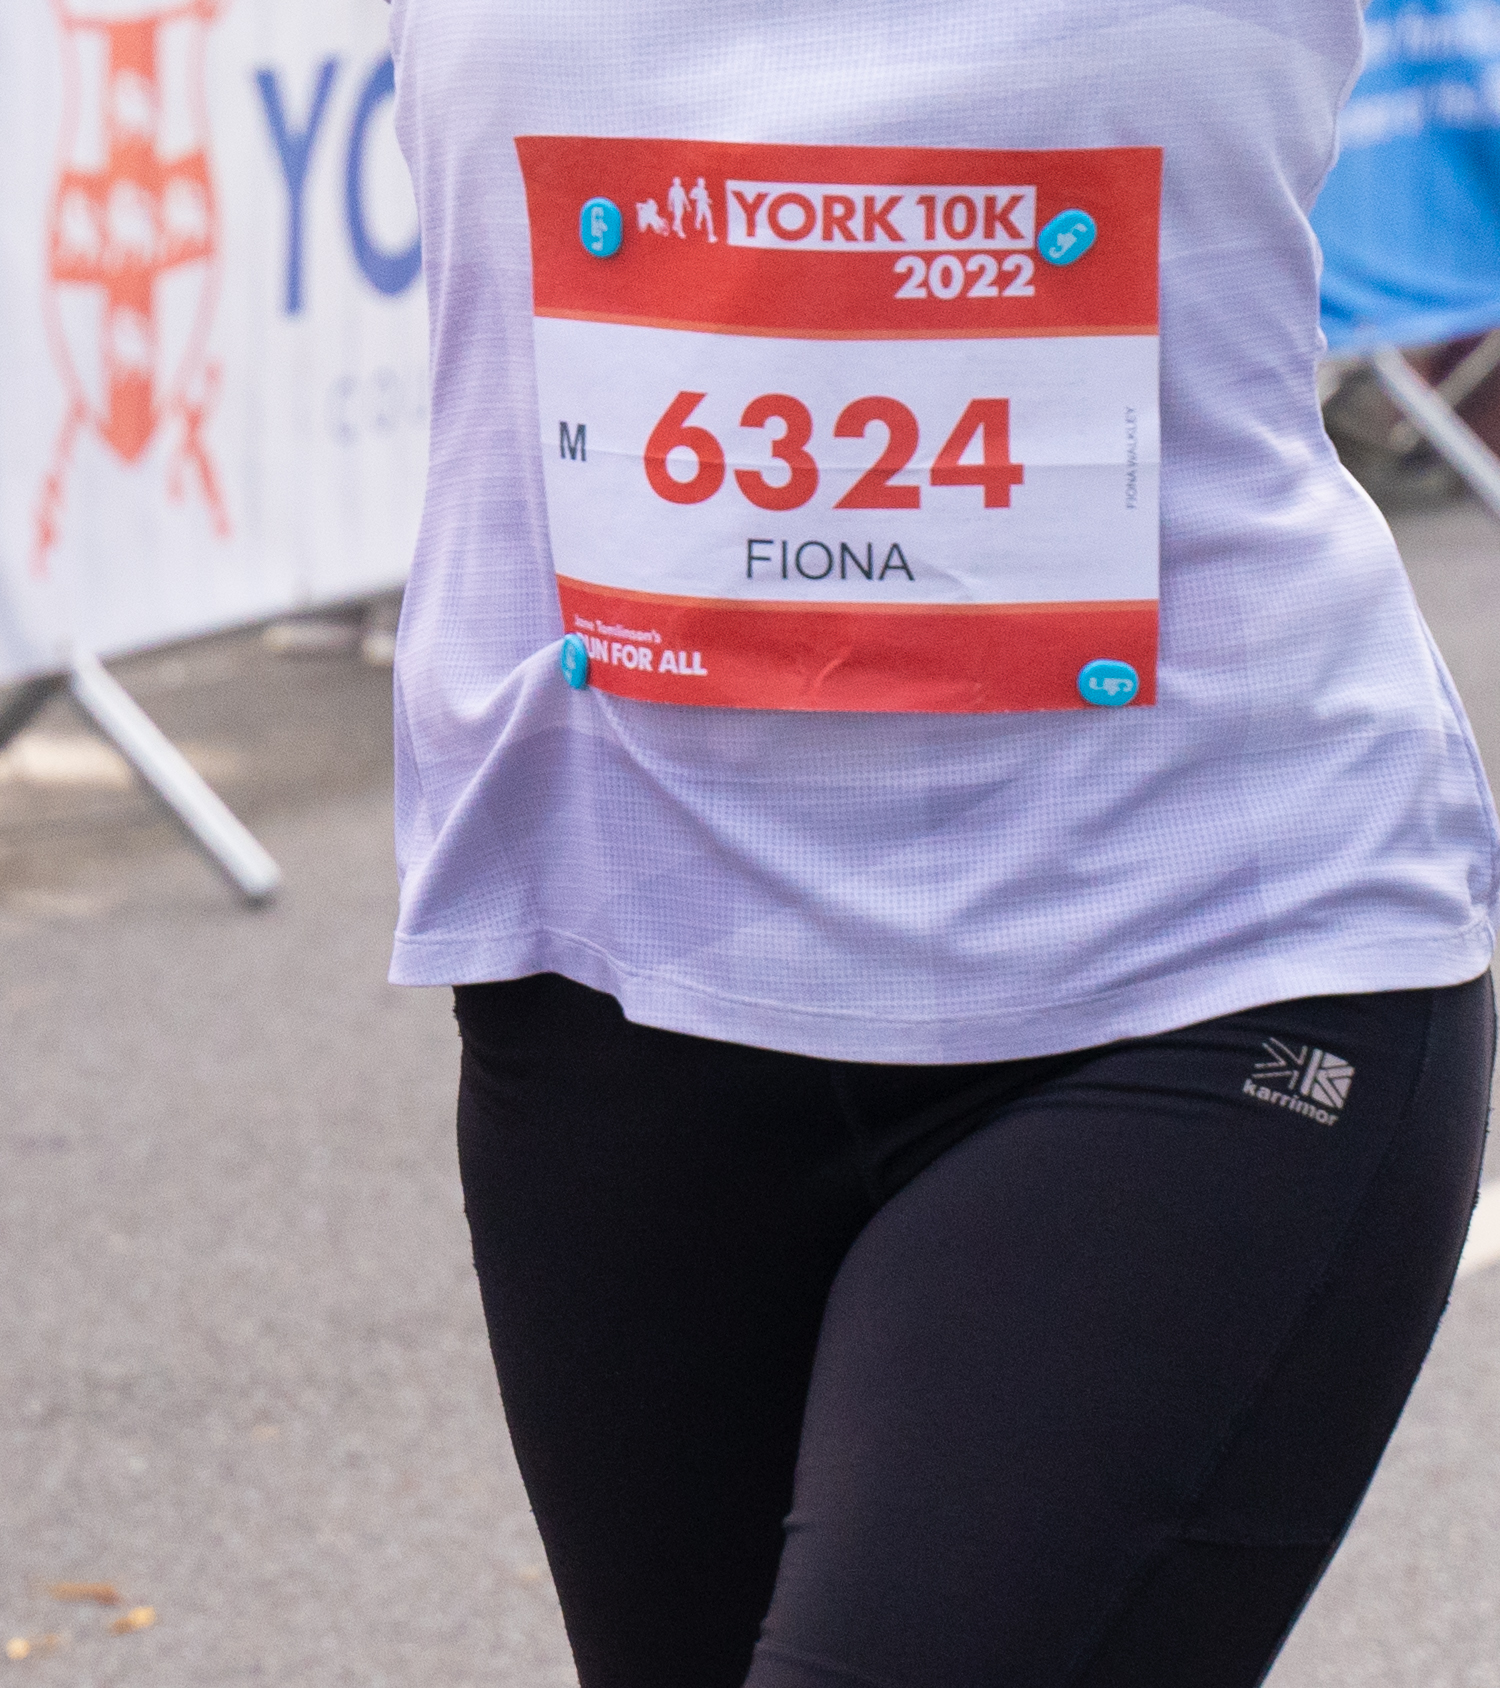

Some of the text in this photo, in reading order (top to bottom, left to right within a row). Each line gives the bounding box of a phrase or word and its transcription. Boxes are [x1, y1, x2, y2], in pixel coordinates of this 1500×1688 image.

[248, 50, 424, 320] YO
[733, 191, 1028, 244] YORK 10K
[893, 253, 1036, 301] 2022
[558, 421, 588, 462] M
[643, 390, 1025, 512] 6324
[745, 538, 915, 582] FIONA
[611, 641, 653, 672] FOR
[658, 650, 708, 677] ALL
[1242, 1078, 1339, 1127] karrimor
